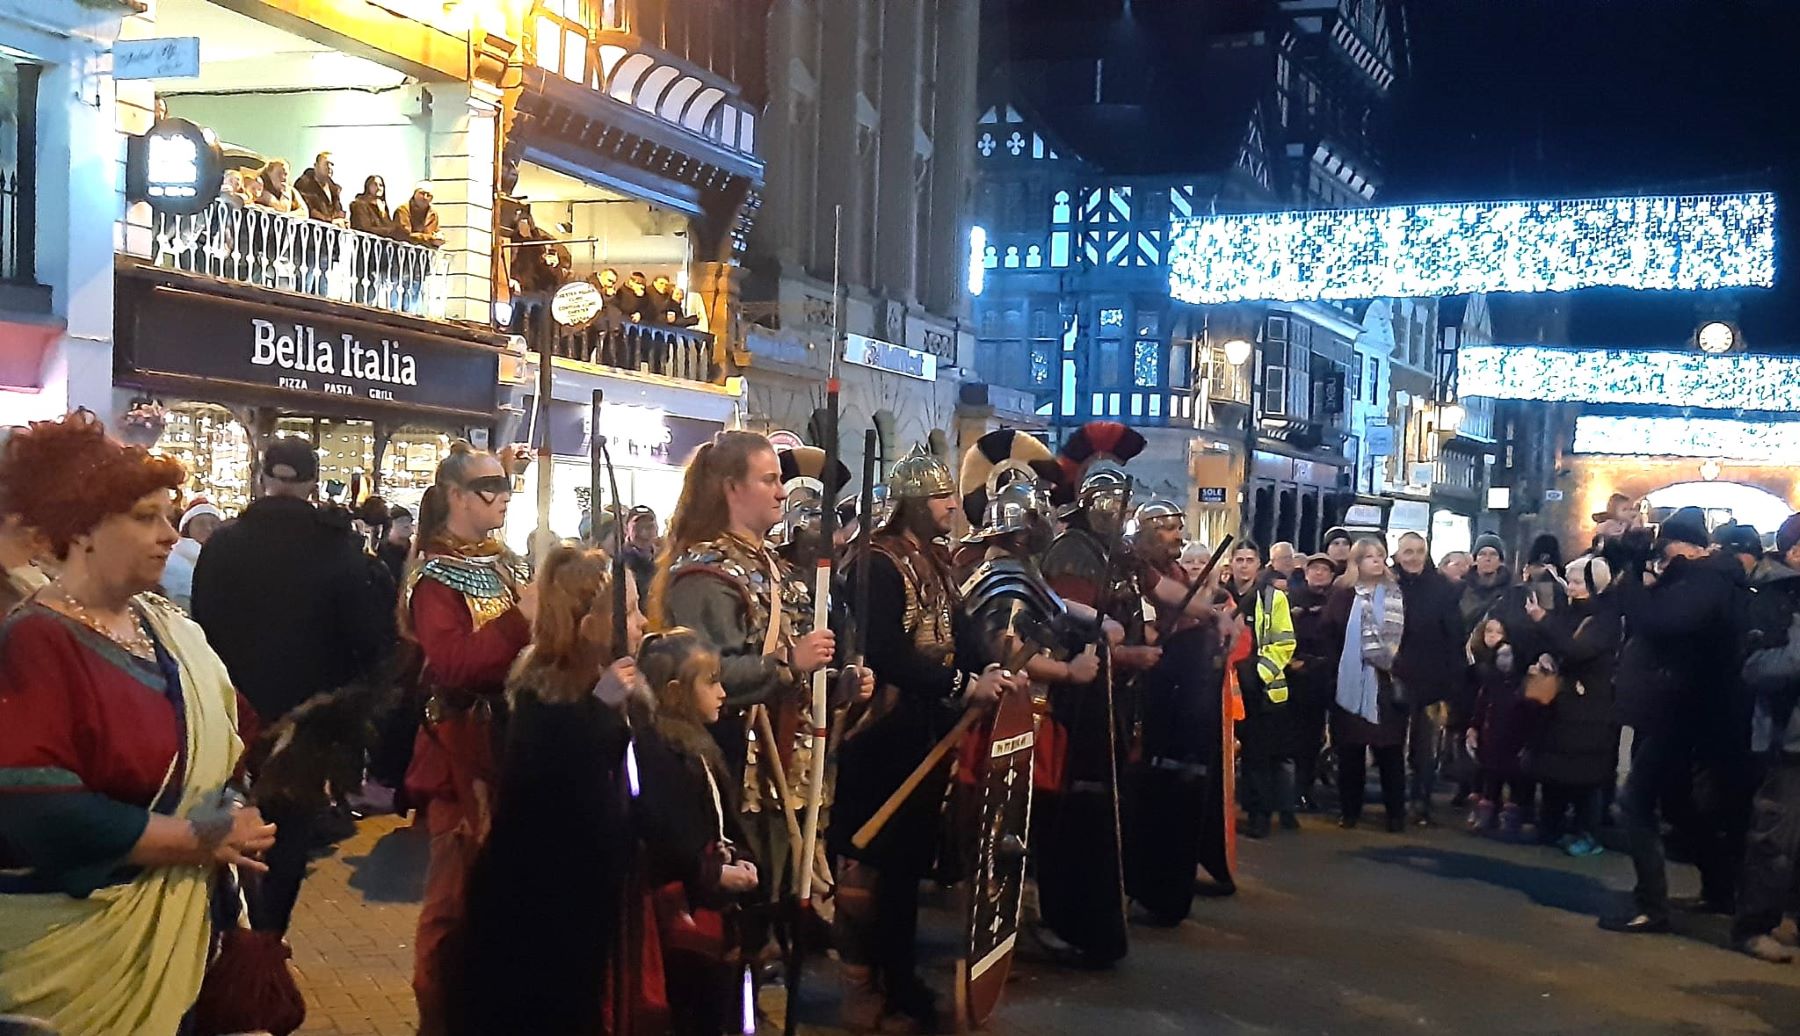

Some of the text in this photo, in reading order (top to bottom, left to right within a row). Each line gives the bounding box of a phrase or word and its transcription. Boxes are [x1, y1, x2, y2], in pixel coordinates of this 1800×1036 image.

[251, 319, 417, 386] Bella Italia
[278, 376, 394, 401] PIZZA PASTA GRILL
[1202, 488, 1223, 496] SOLE
